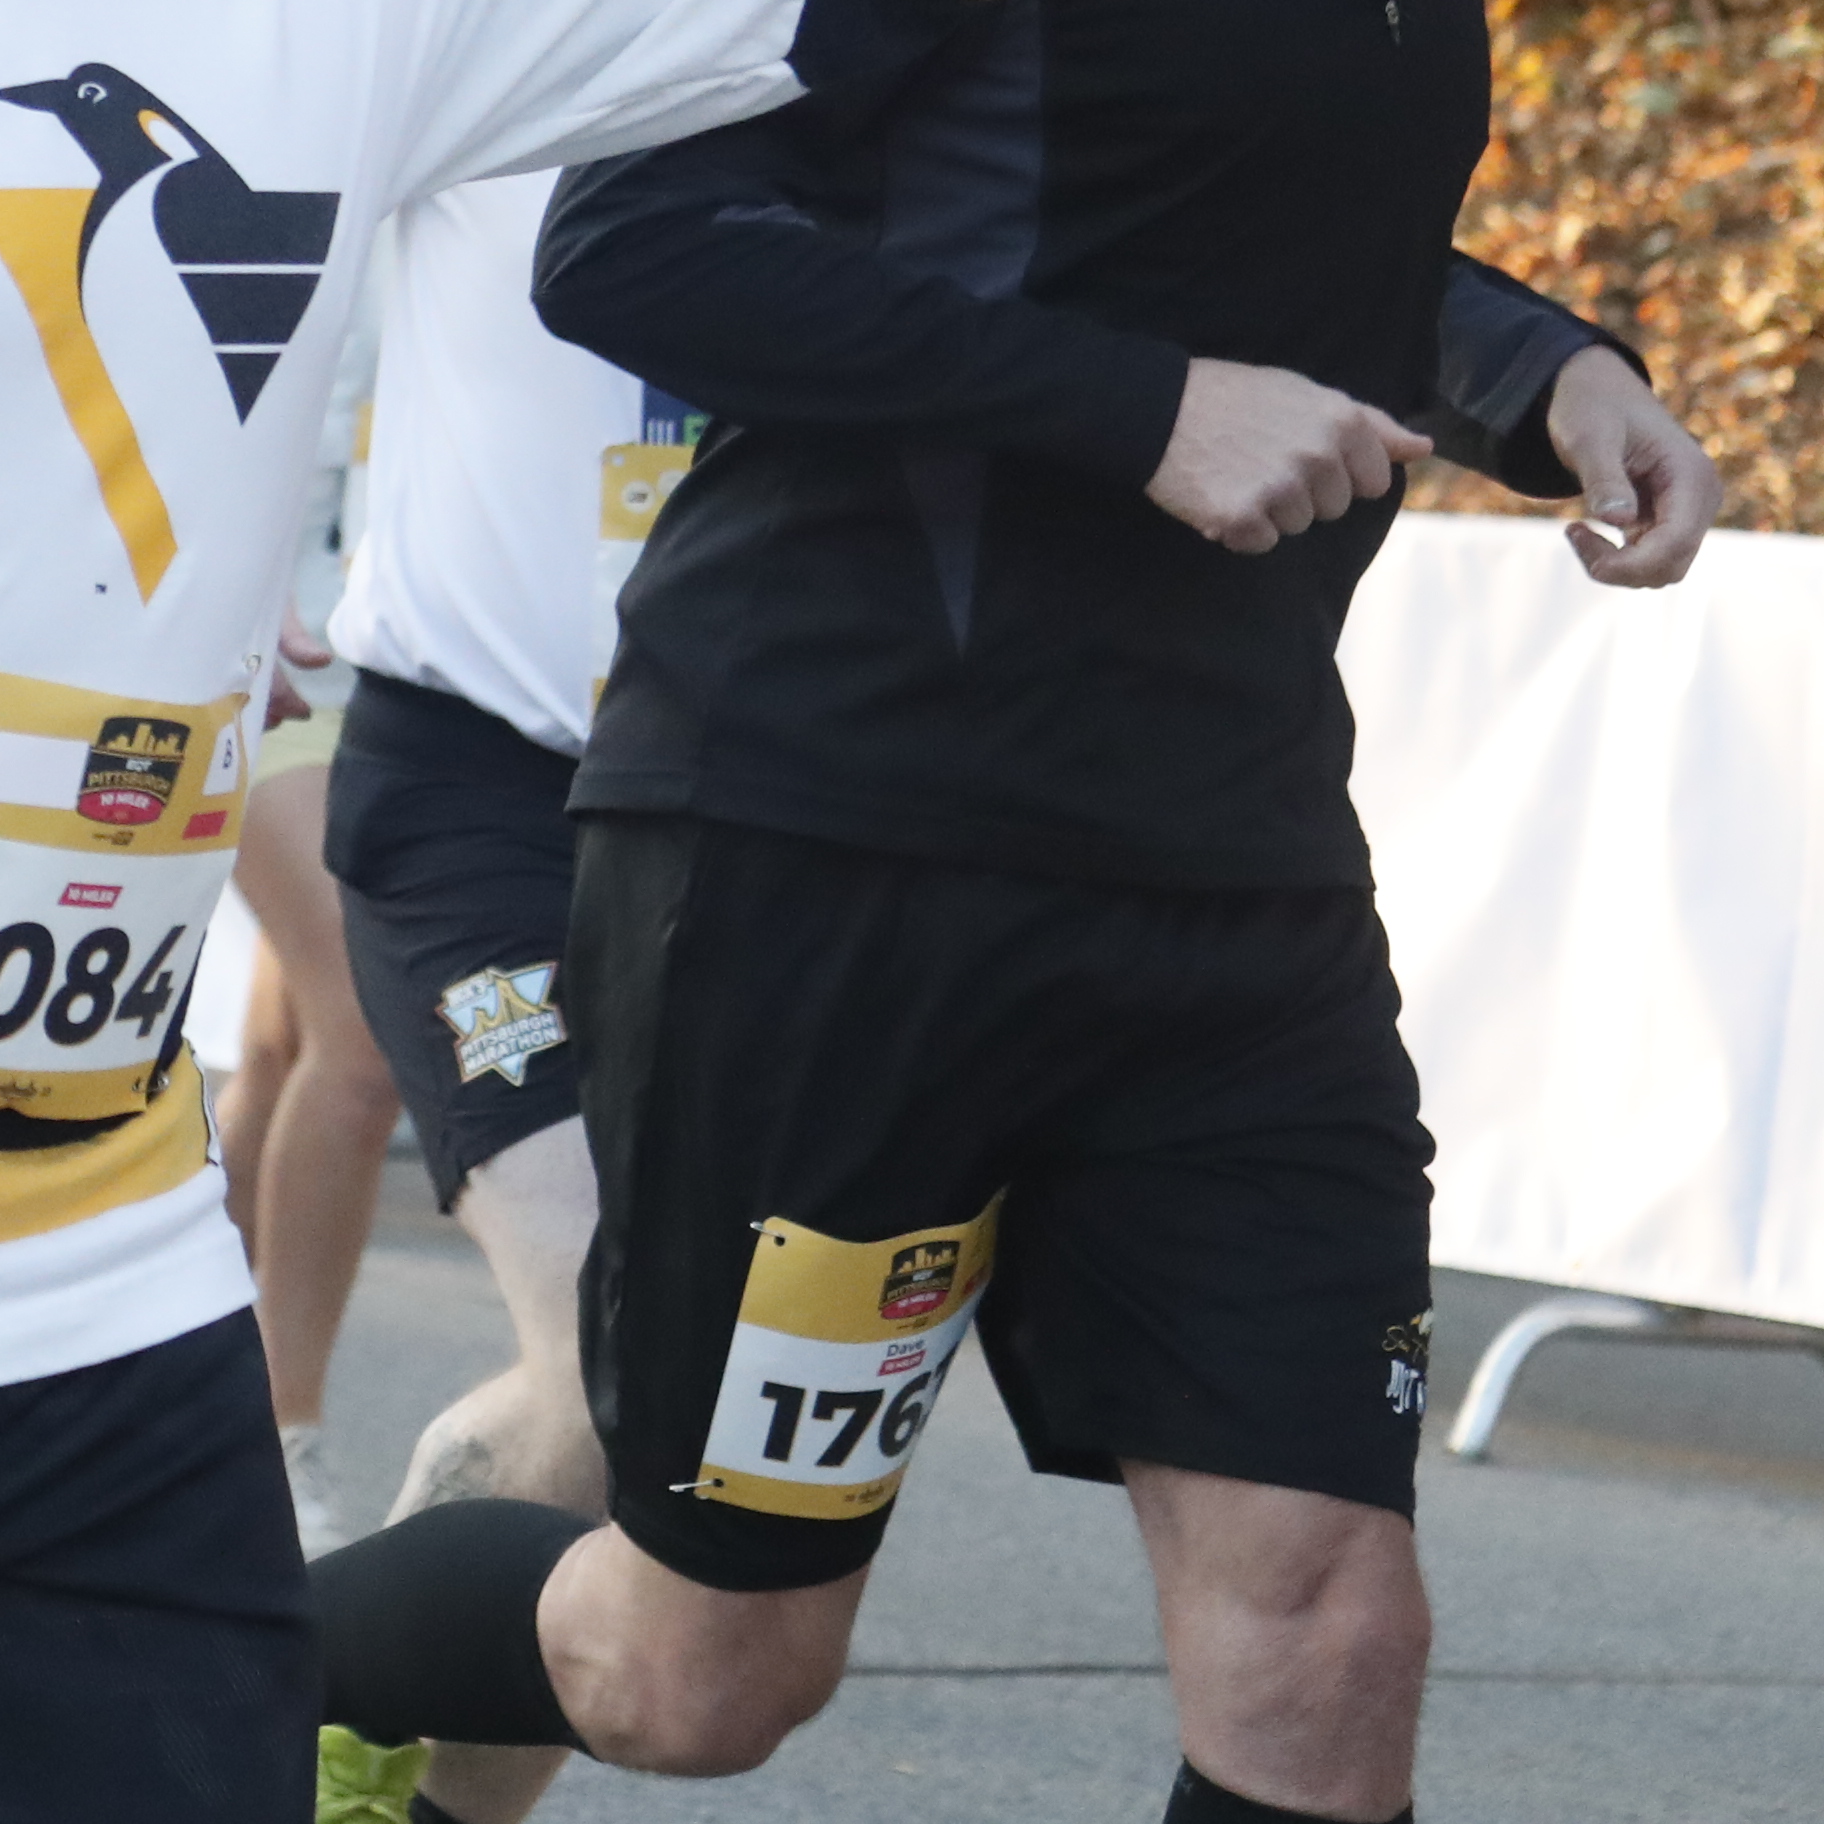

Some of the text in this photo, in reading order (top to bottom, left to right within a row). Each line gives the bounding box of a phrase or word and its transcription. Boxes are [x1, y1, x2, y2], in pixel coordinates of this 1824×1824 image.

[460, 1012, 556, 1056] PITTSBURGH
[464, 1027, 561, 1075] MARATHON
[886, 1340, 926, 1358] Dave
